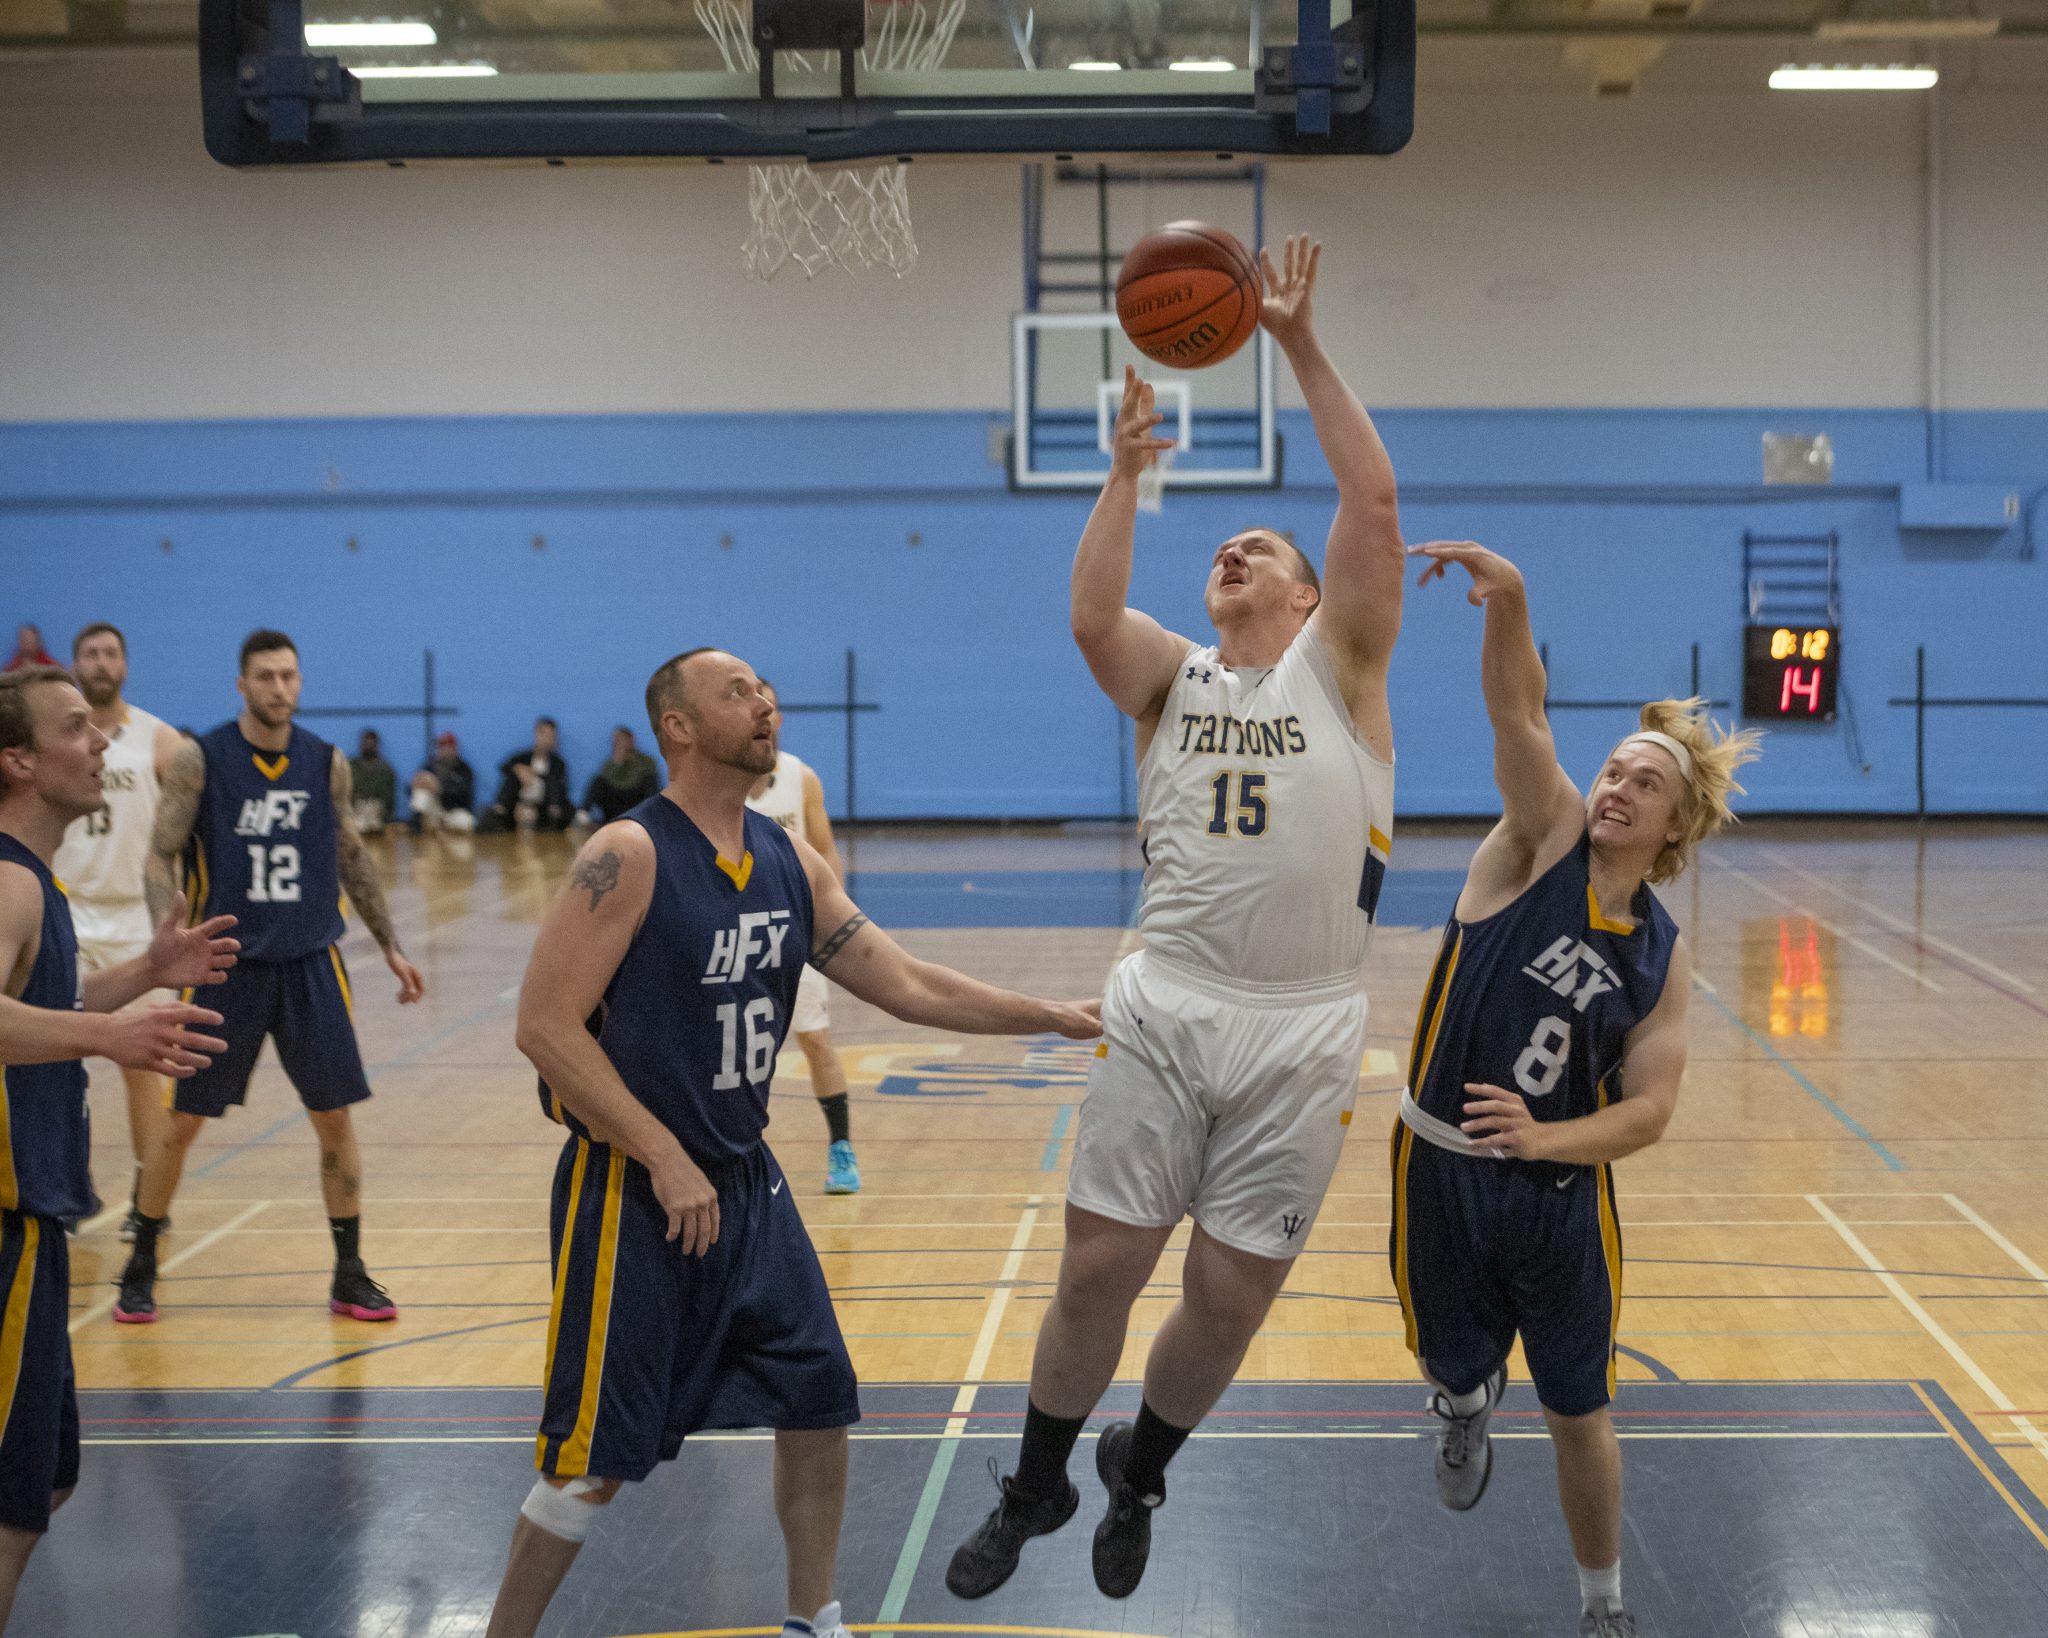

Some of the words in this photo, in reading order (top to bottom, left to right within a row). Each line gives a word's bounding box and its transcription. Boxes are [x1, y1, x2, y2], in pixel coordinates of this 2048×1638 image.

[1780, 665, 1822, 712] 14
[234, 789, 311, 836] HFX
[1206, 769, 1269, 839] 15
[246, 844, 301, 902] 12
[701, 910, 790, 984] HFX
[713, 997, 776, 1090] 16
[1512, 1015, 1571, 1097] 8
